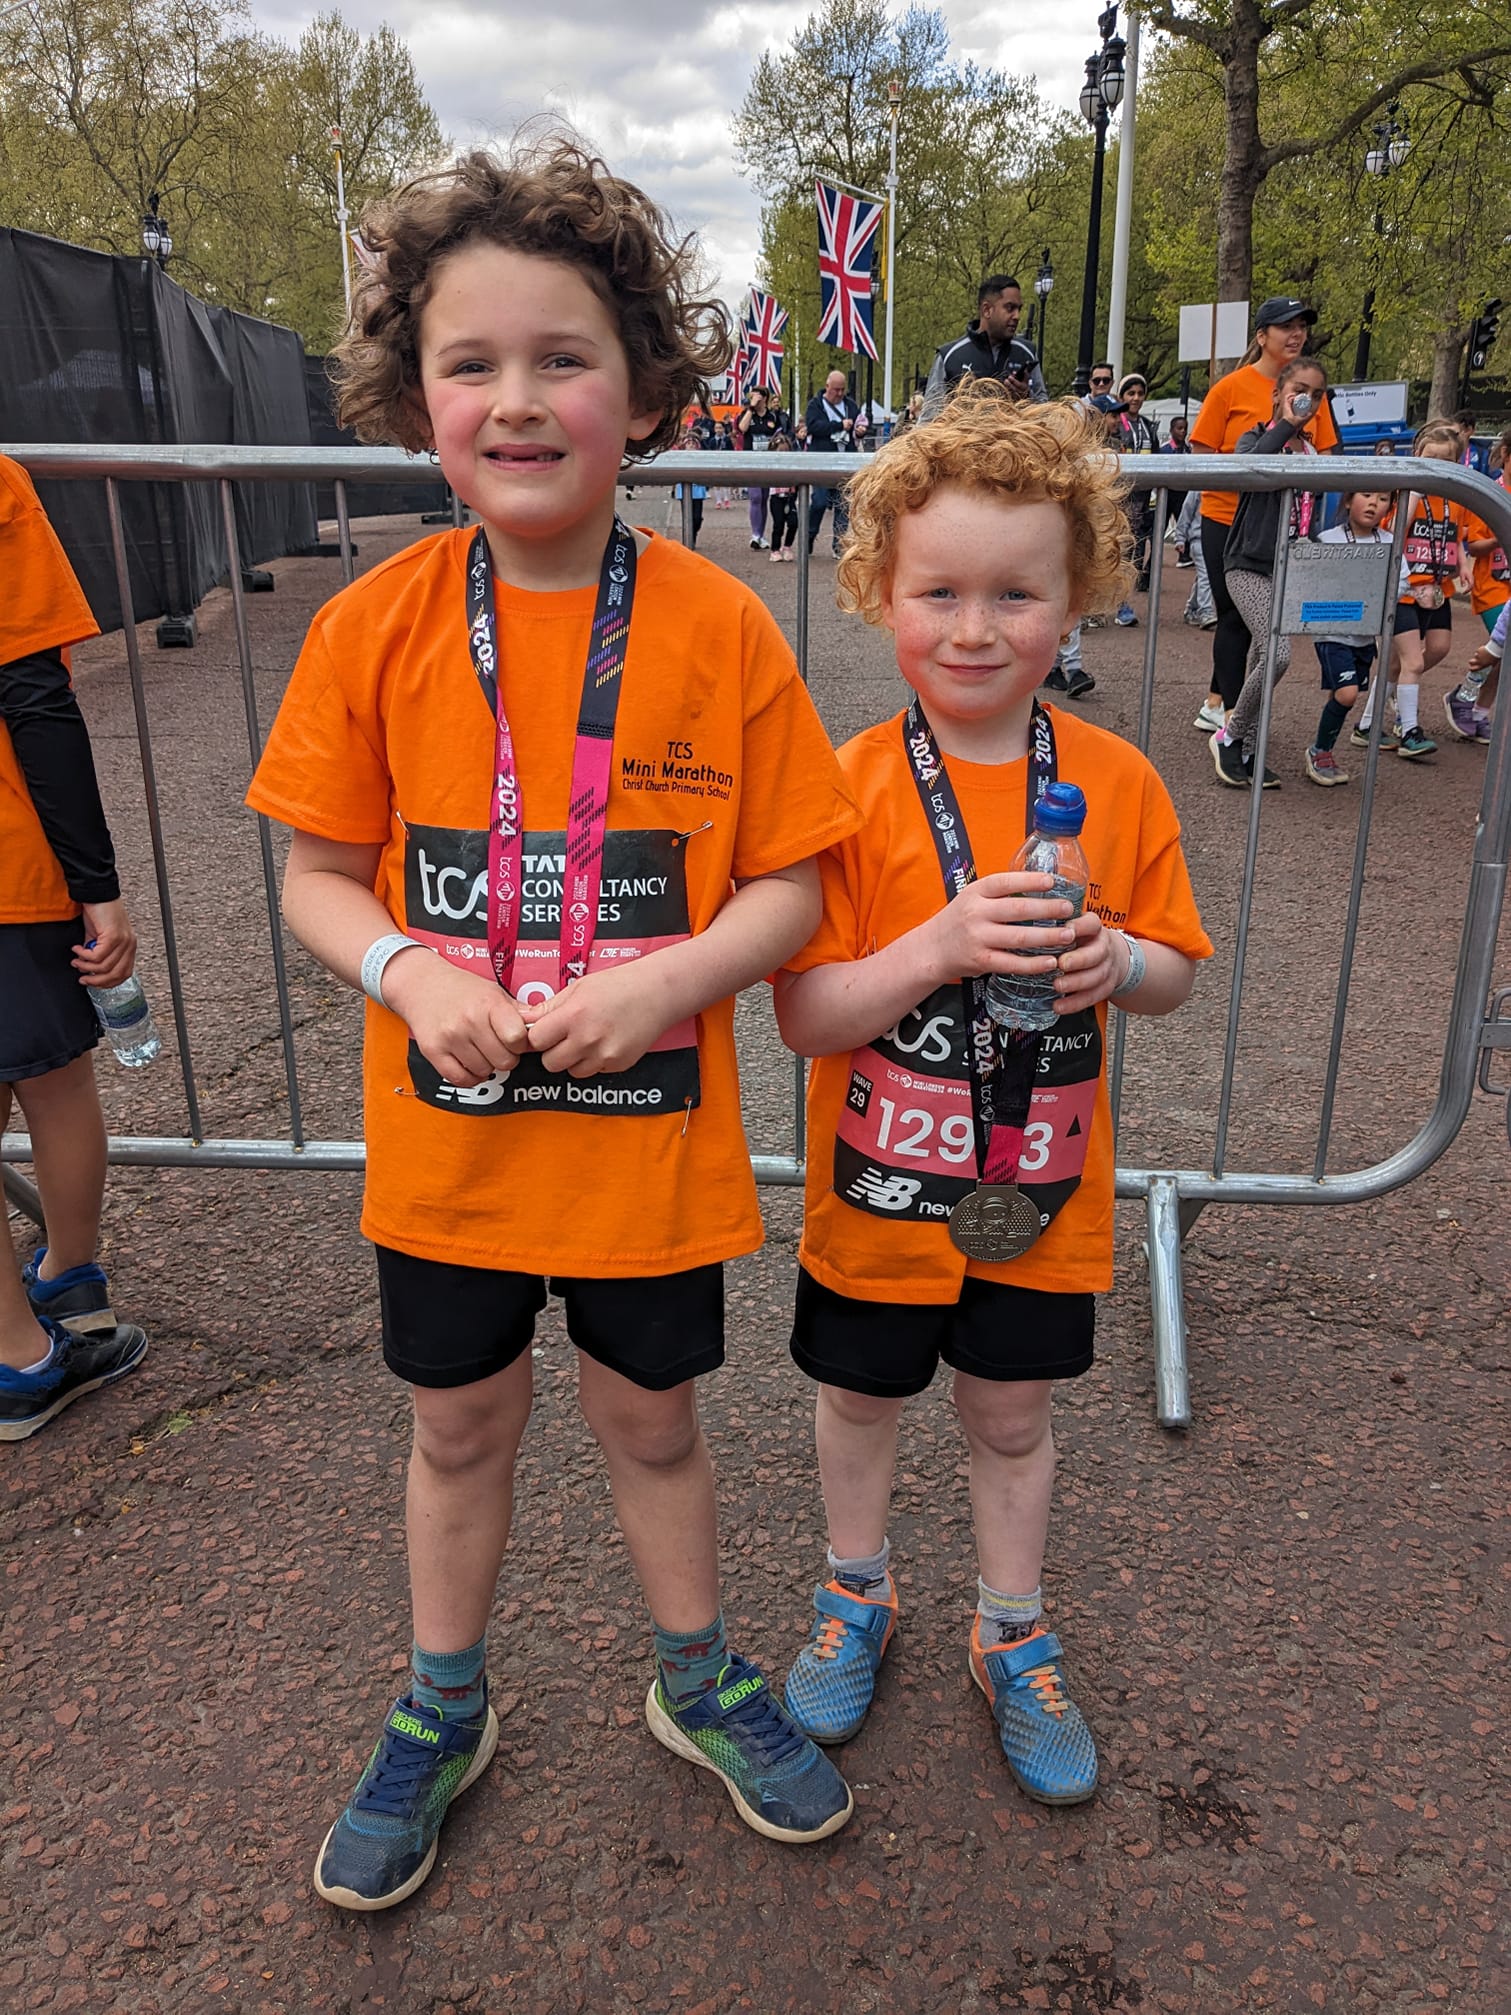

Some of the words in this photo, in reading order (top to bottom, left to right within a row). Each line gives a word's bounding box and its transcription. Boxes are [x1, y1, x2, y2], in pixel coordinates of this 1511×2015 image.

[473, 613, 494, 675] 2024
[667, 741, 694, 760] TCS
[1034, 717, 1052, 765] 2024
[909, 731, 940, 782] 2024
[622, 757, 656, 778] Mini
[662, 761, 734, 788] Marathon
[622, 778, 643, 790] Christ
[645, 779, 670, 792] Church
[671, 781, 705, 798] Primary
[707, 784, 730, 801] School
[497, 773, 518, 837] 2024
[930, 792, 946, 814] tcs
[499, 856, 513, 879] tcs
[521, 855, 567, 873] TAT
[521, 876, 668, 898] CONLTANCY
[570, 925, 585, 947] tcs
[446, 943, 460, 956] tcs
[972, 1018, 995, 1075] 2024
[853, 1071, 874, 1093] WAVE
[513, 1084, 562, 1103] new
[567, 1082, 663, 1106] balance
[850, 1087, 866, 1108] 29
[980, 1084, 994, 1105] tcs
[876, 1096, 1054, 1171] 1293
